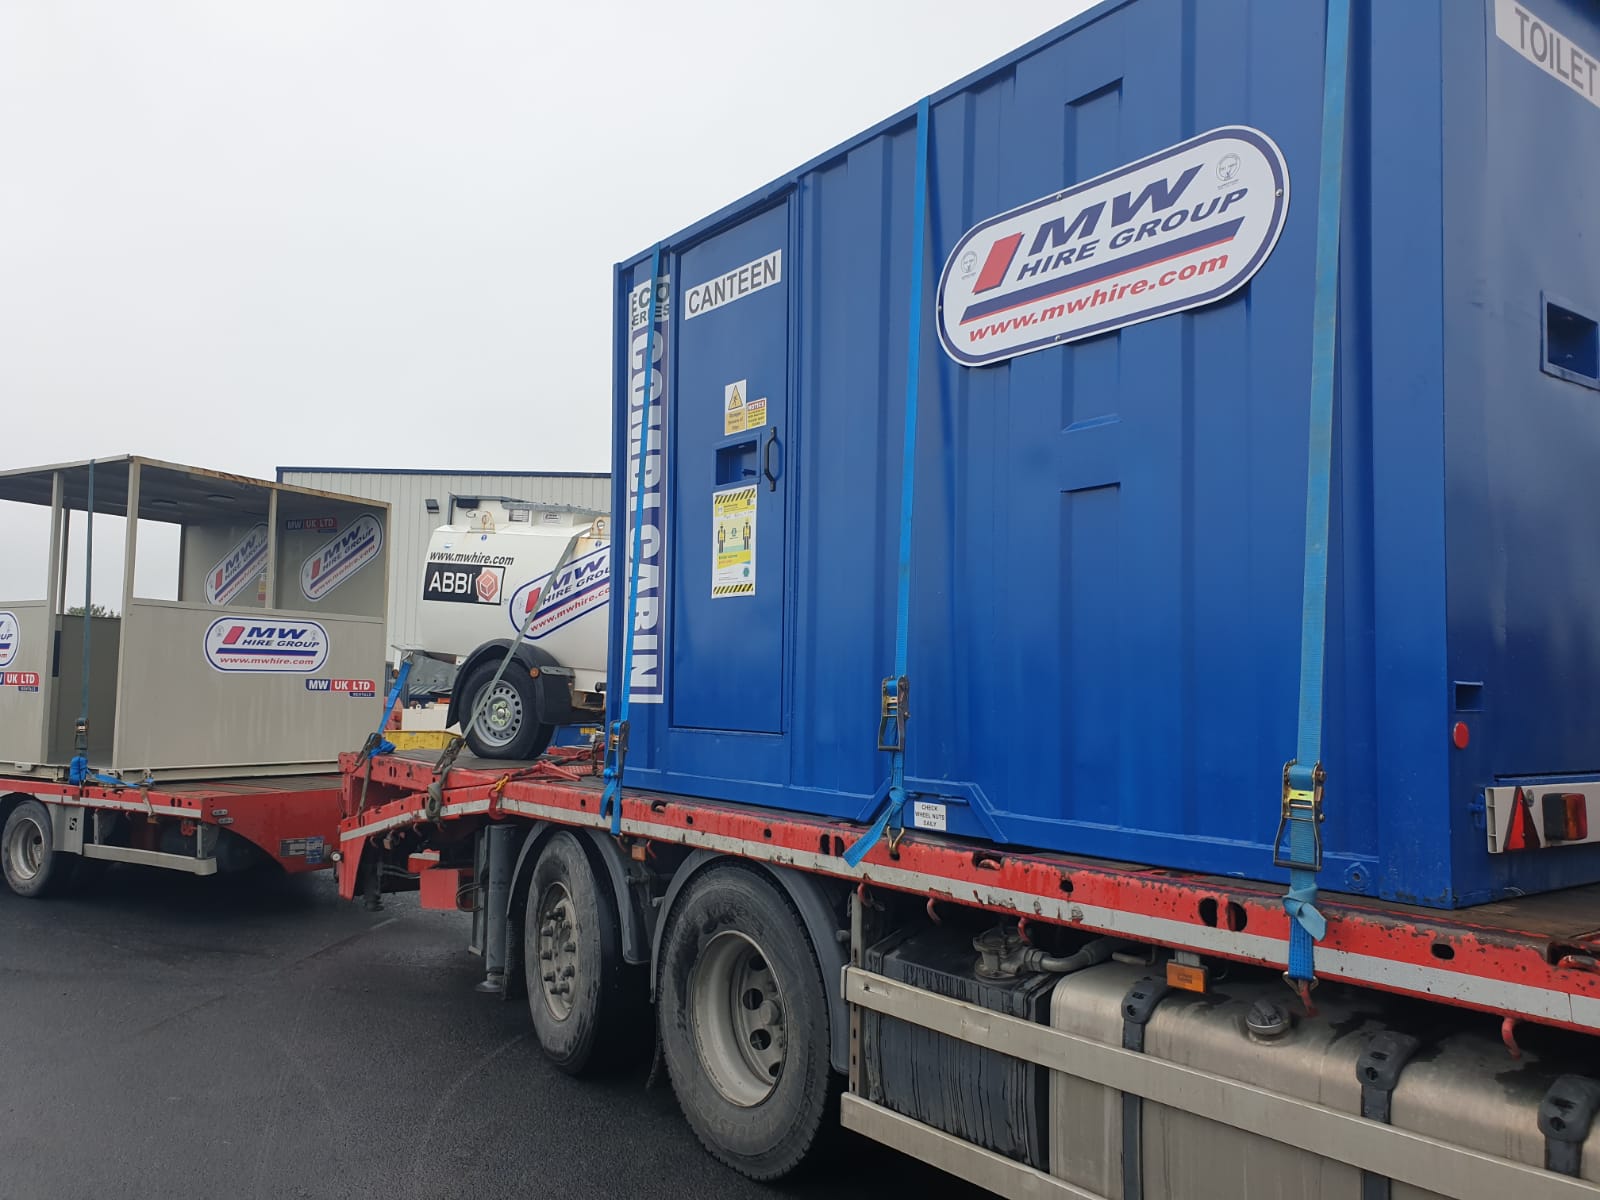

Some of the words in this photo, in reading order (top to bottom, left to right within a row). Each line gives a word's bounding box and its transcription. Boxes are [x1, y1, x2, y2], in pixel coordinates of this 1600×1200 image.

[1514, 6, 1598, 97] TOILET
[1027, 163, 1204, 257] MW
[1016, 239, 1099, 281] HIRE
[1108, 187, 1249, 250] GROUP
[688, 255, 777, 314] CANTEEN
[968, 254, 1229, 343] www.mwhire.com
[305, 519, 317, 529] UK
[320, 518, 334, 528] LTD
[225, 534, 257, 574] MW
[324, 525, 361, 563] MW
[429, 551, 515, 566] www.mwhire.com
[428, 570, 473, 595] ABBI
[543, 585, 573, 606] HIRE
[630, 525, 661, 687] CABIN
[242, 639, 275, 647] HIRE
[276, 640, 320, 648] GROUP
[246, 626, 308, 640] MW
[219, 657, 314, 665] www.mwhire.com
[6, 673, 18, 684] UK
[20, 673, 35, 684] LTD
[308, 679, 329, 690] MW
[334, 680, 349, 690] UK
[352, 681, 371, 691] LTD
[915, 811, 931, 819] WHEEL
